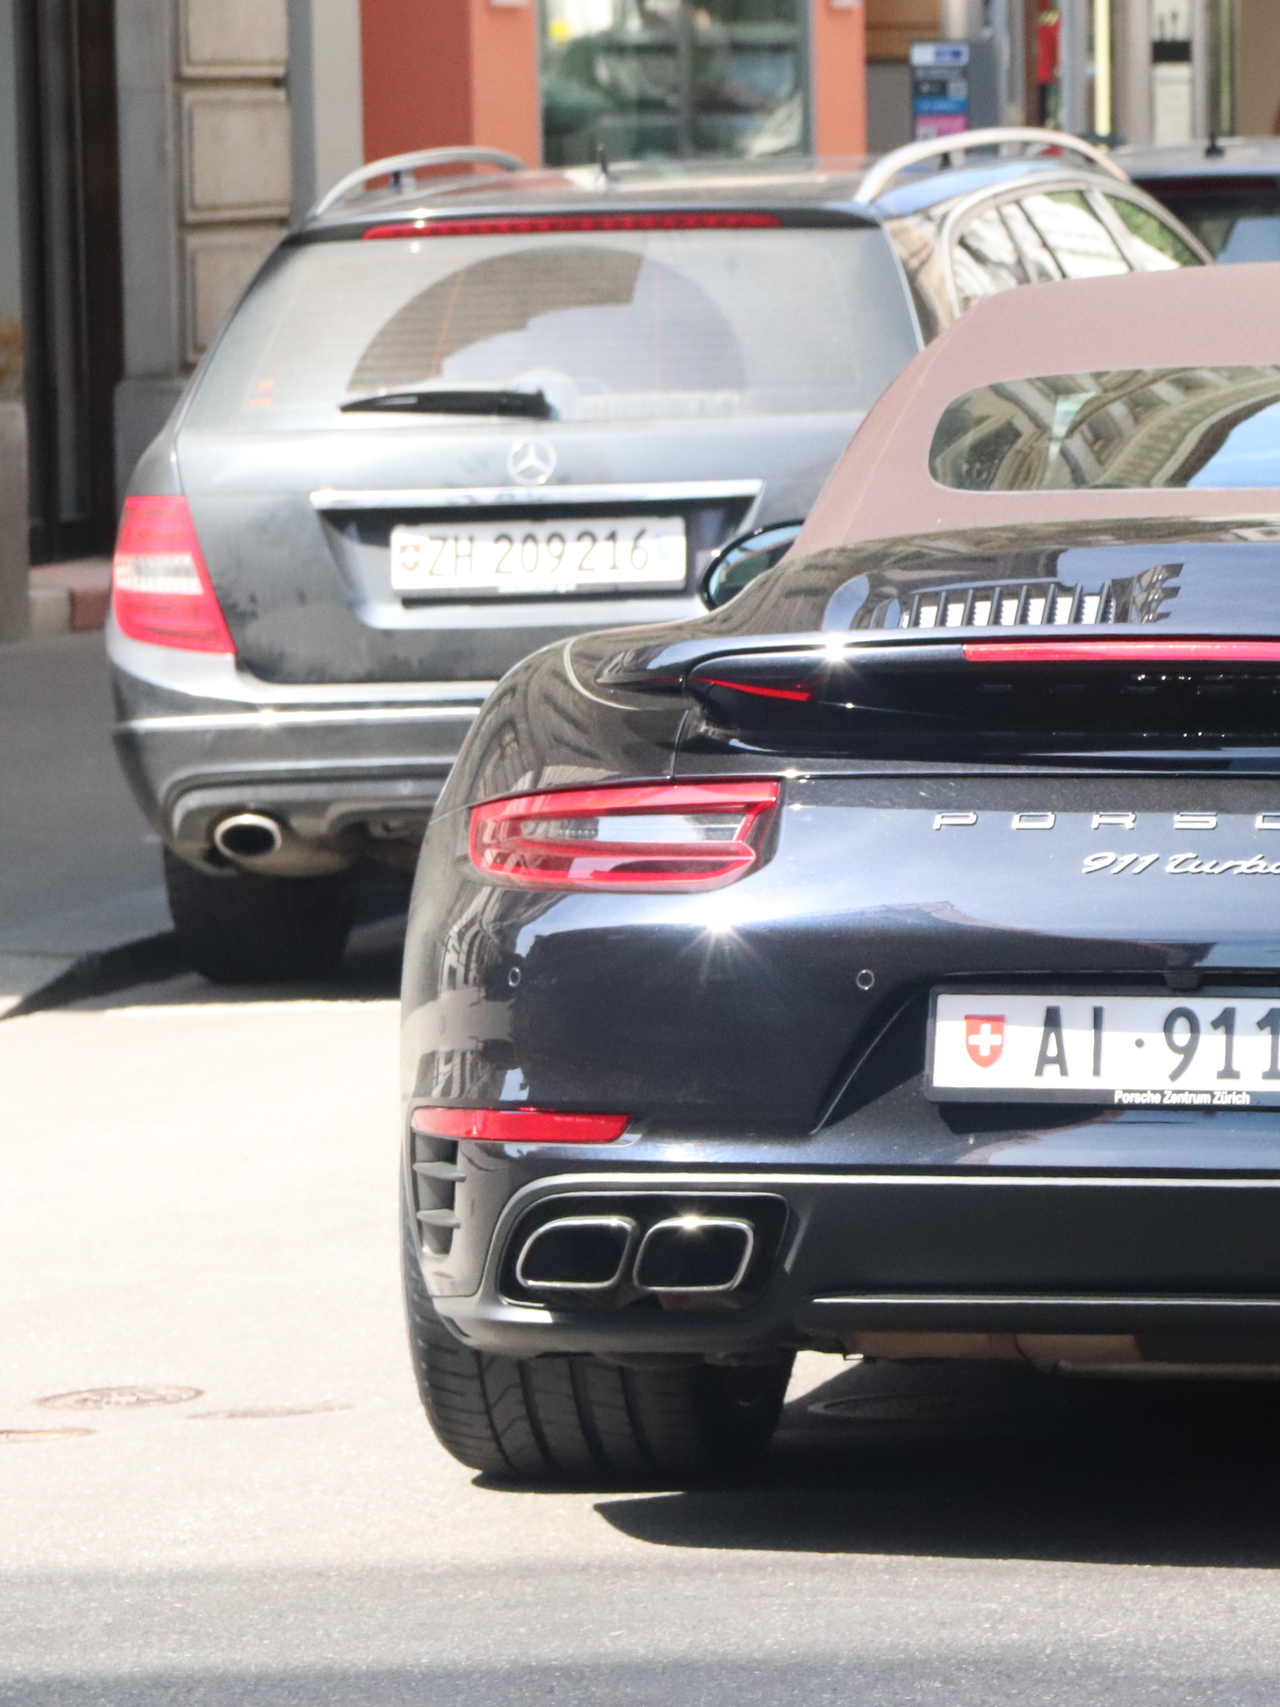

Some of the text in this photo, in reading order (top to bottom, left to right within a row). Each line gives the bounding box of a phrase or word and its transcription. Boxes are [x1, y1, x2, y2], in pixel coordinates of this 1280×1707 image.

[428, 529, 649, 576] ZH 209216
[1082, 852, 1160, 874] 911
[1034, 1005, 1104, 1078] AI
[1114, 1089, 1251, 1106] Porsche Zentrum Zürich
